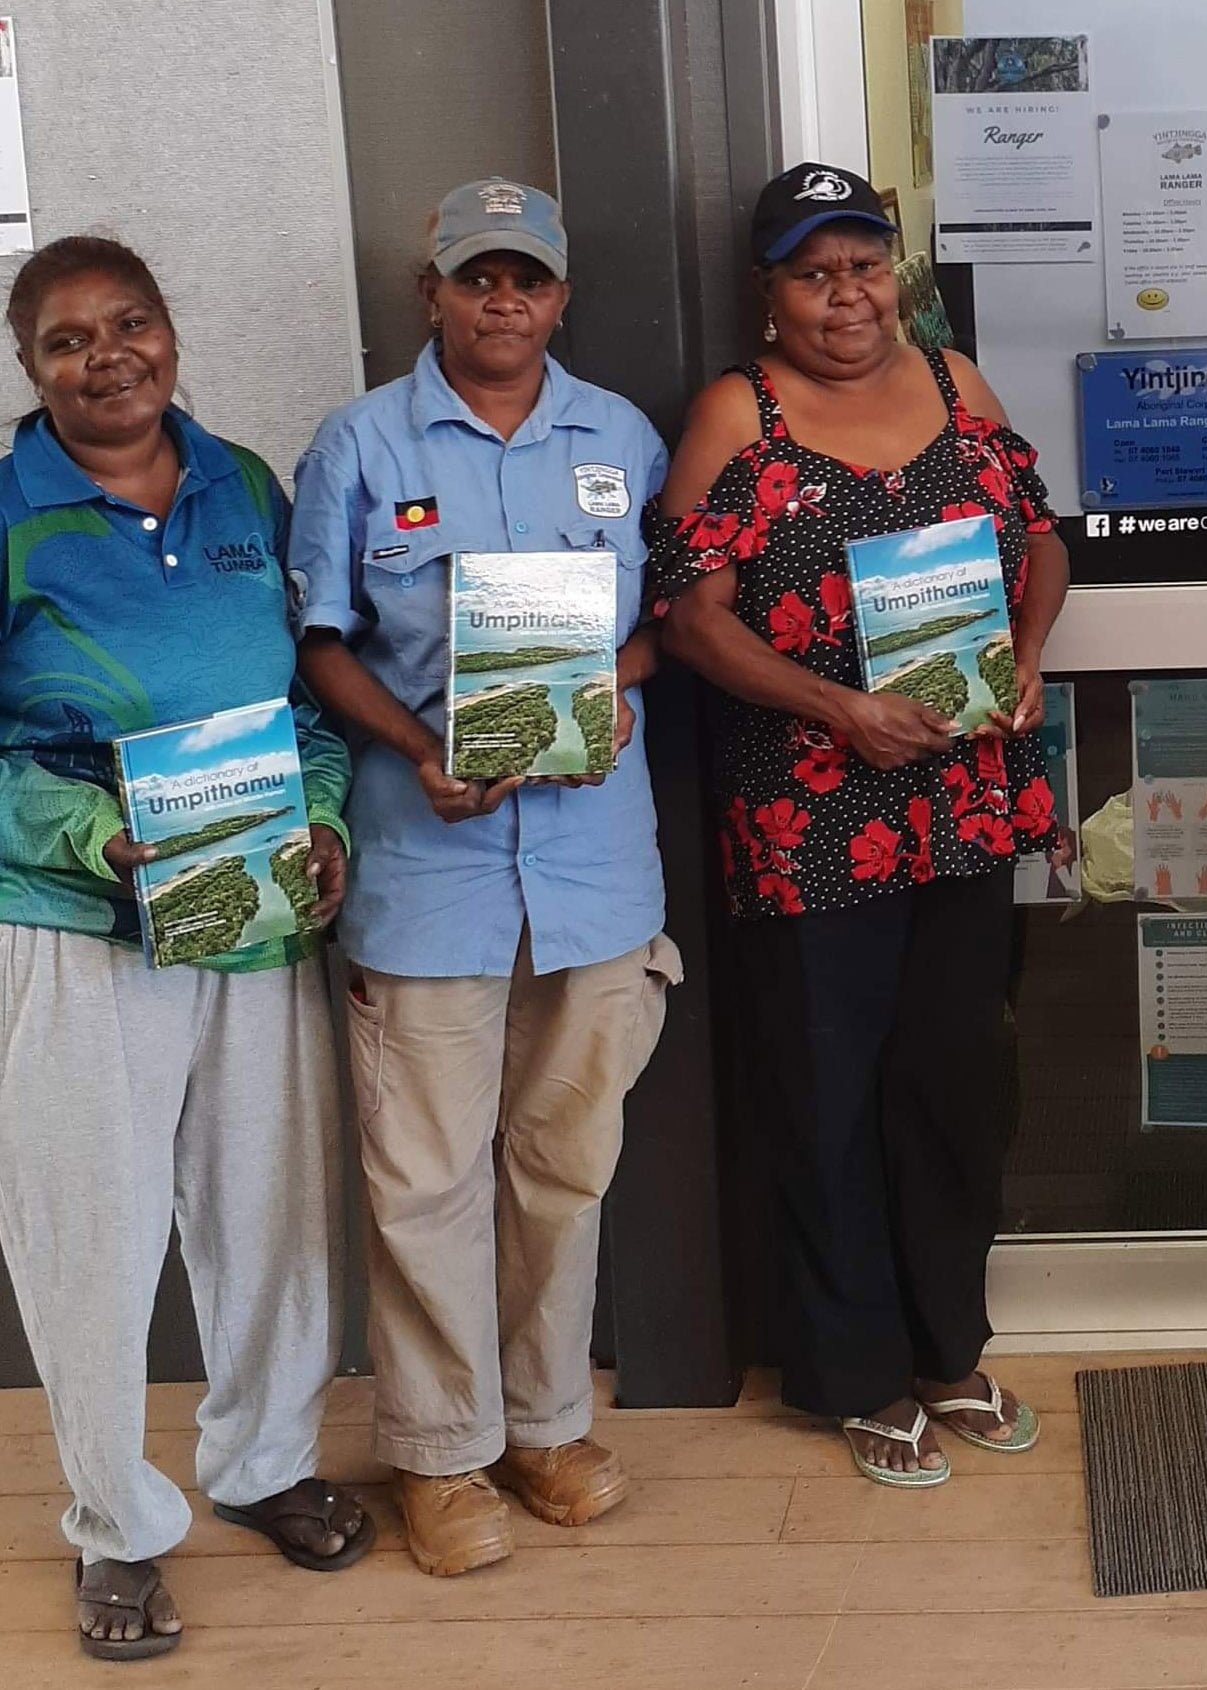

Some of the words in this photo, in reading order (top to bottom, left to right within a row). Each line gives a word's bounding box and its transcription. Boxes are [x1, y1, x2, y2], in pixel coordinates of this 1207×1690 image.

[966, 106, 982, 114] WE
[988, 106, 1010, 114] ARE
[983, 126, 1044, 150] Ranger
[1160, 180, 1202, 190] RANGER
[1137, 401, 1183, 412] Aboriginal
[1106, 418, 1140, 430] Lama
[1143, 417, 1177, 428] Lama
[903, 571, 954, 588] dictionary
[873, 578, 990, 612] Umpithamu
[171, 780, 182, 790] A
[184, 766, 244, 787] dictionary
[247, 762, 258, 772] of
[149, 773, 285, 814] Umpithamu
